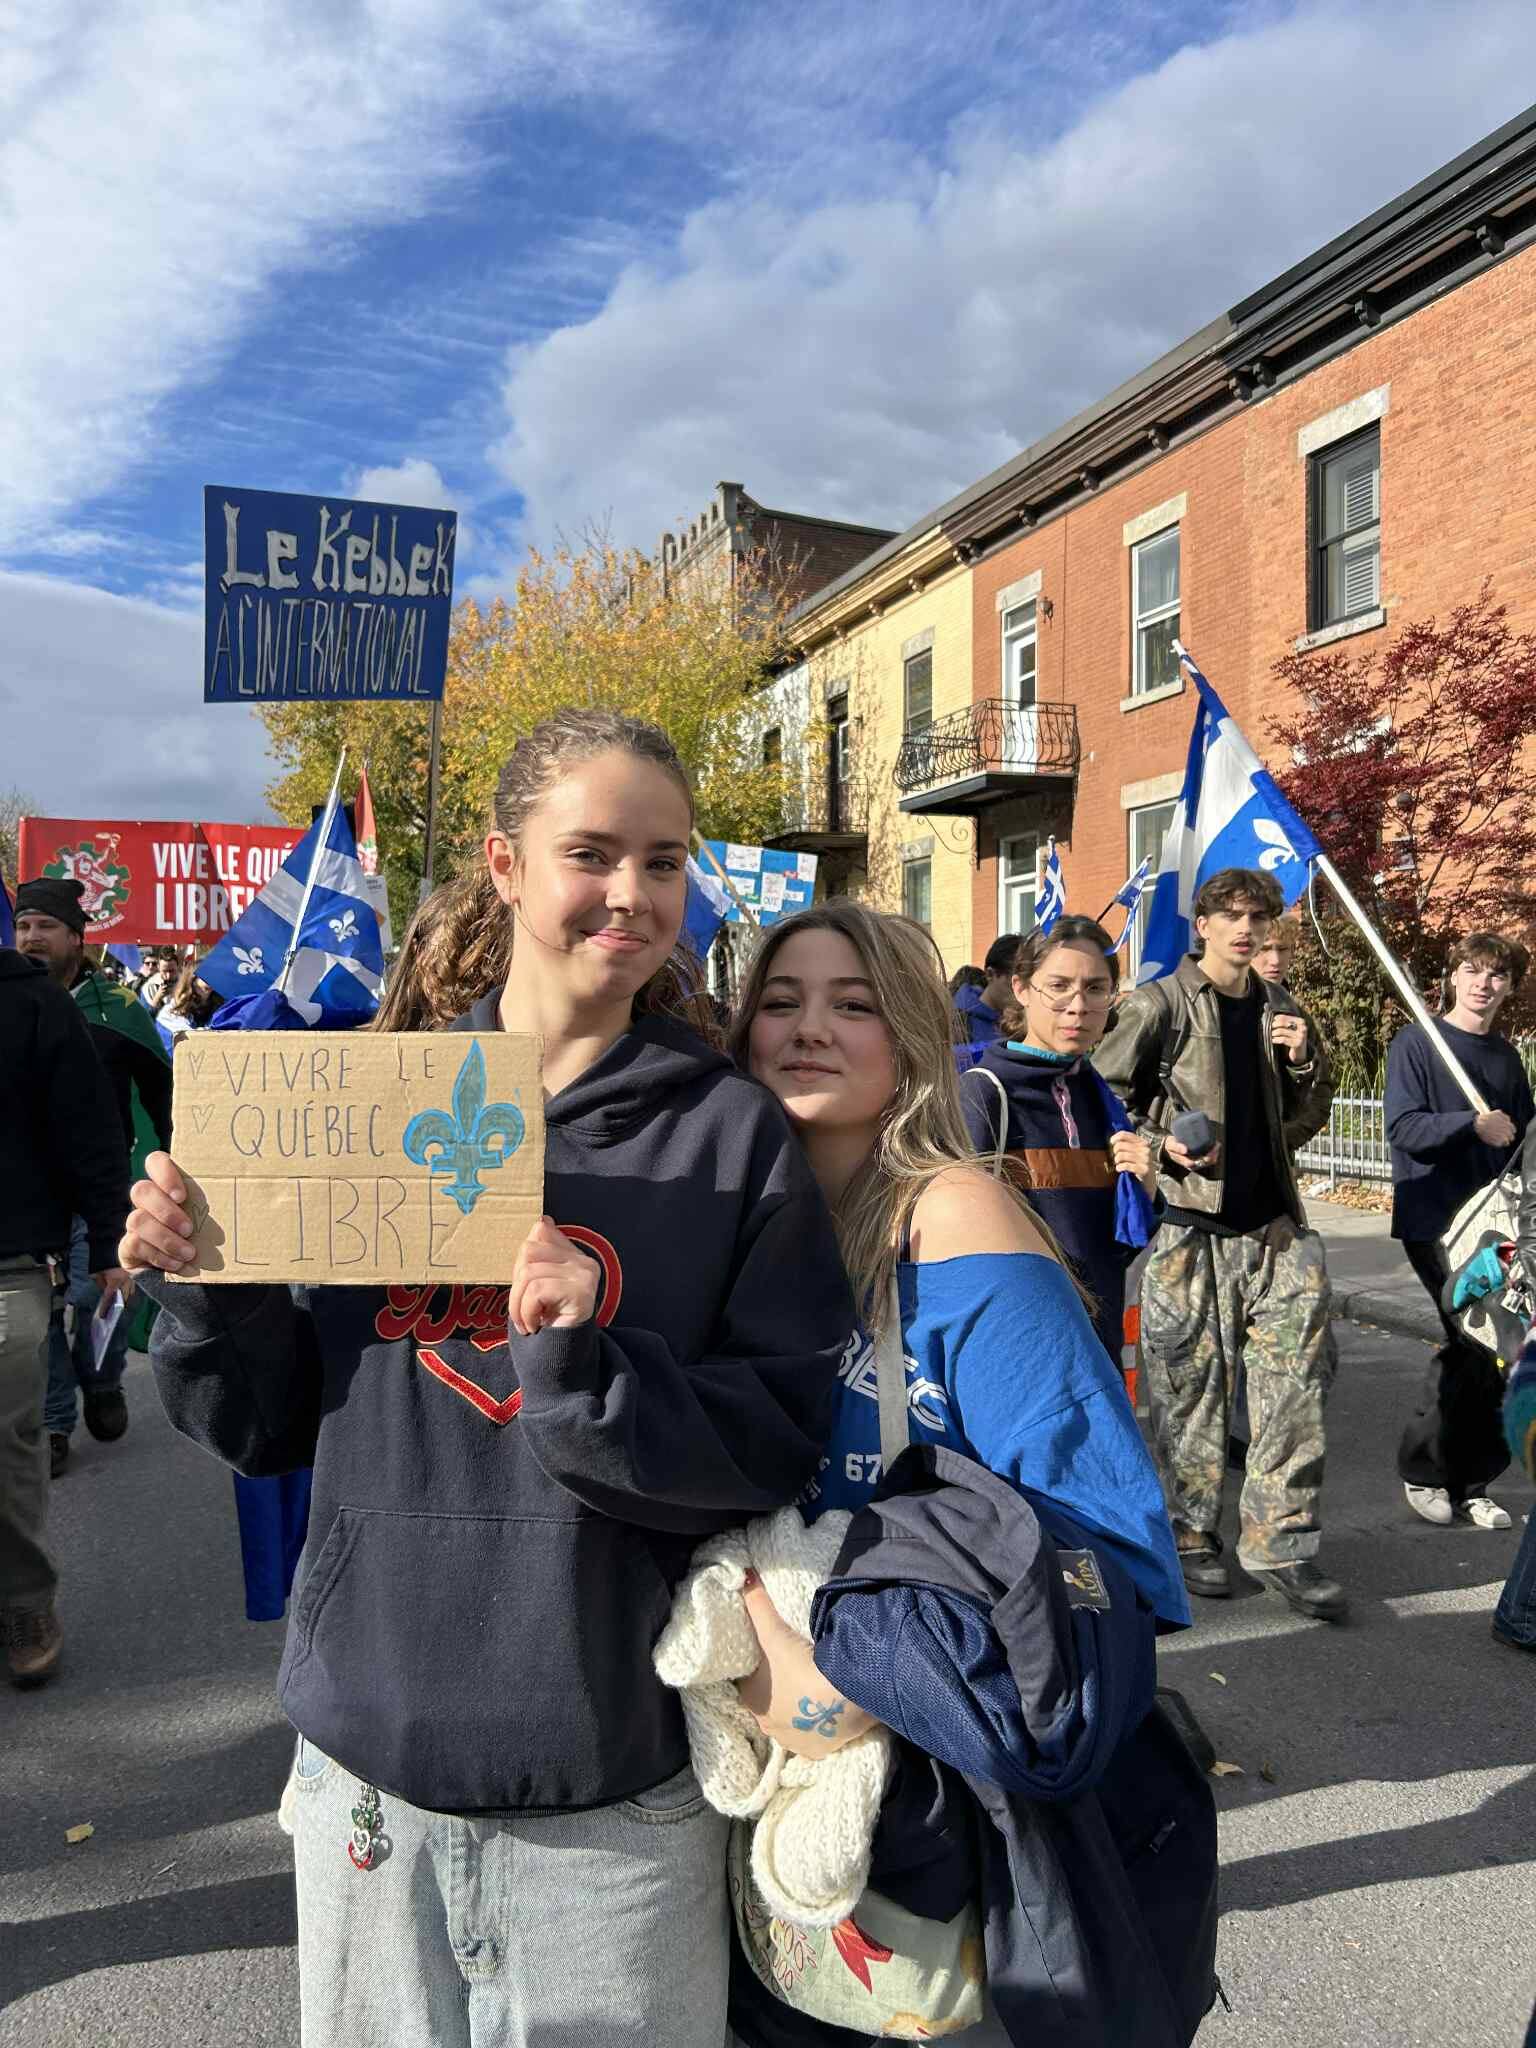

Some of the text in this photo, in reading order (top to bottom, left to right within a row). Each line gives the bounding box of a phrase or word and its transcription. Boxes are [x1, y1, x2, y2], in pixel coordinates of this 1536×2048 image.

[221, 501, 456, 597] Le KebbeK
[152, 842, 208, 879] VIVE
[215, 844, 240, 881] LE
[222, 1047, 435, 1096] VIVRE LE
[230, 1100, 385, 1158] QUÉBEC
[233, 1175, 457, 1269] LIBRE
[845, 1453, 881, 1484] 67
